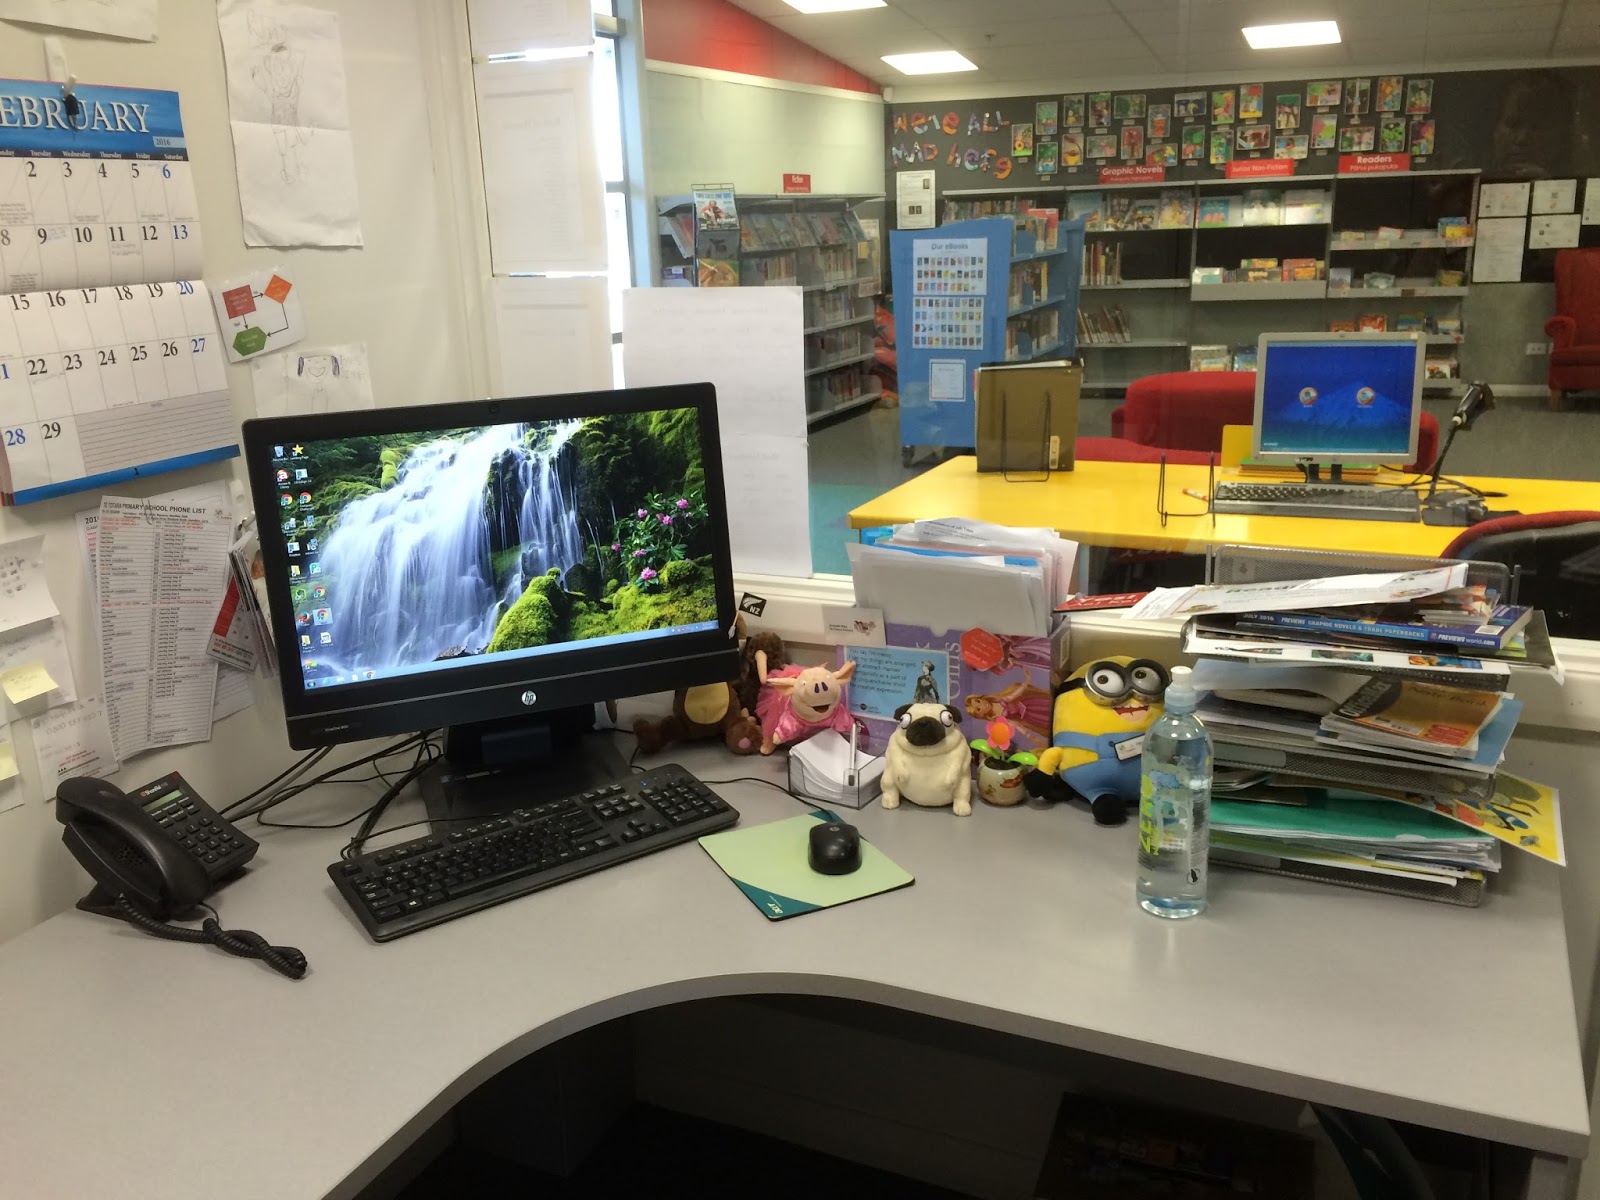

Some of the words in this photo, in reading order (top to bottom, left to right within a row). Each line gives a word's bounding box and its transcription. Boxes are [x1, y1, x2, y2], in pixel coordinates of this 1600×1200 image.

[155, 138, 171, 146] 2016
[30, 149, 51, 157] Tuesday
[62, 150, 91, 159] Wednesday
[99, 151, 122, 159] Thursday
[135, 152, 150, 161] Friday
[163, 153, 184, 161] Saturday
[1357, 155, 1392, 164] Readers
[27, 161, 37, 178] 2
[63, 161, 73, 178] 3
[98, 162, 108, 178] 4
[131, 162, 140, 179] 5
[162, 163, 171, 179] 6
[1102, 167, 1134, 176] Graphic
[1136, 165, 1163, 174] Novels
[1252, 164, 1289, 172] Non-Fiction
[0, 229, 11, 246] 8
[37, 228, 48, 245] 9
[75, 226, 93, 243] 10
[109, 226, 125, 242] 11
[142, 225, 158, 241] 12
[173, 224, 189, 240] 13
[114, 285, 134, 301] 18
[146, 282, 164, 298] 19
[176, 280, 194, 295] 20
[10, 294, 30, 311] 15
[46, 290, 66, 308] 16
[81, 288, 98, 304] 17
[161, 341, 178, 357] 26
[191, 337, 206, 353] 27
[98, 349, 117, 366] 24
[130, 345, 148, 362] 25
[26, 357, 48, 376] 22
[63, 353, 83, 371] 23
[5, 428, 26, 447] 28
[41, 421, 61, 440] 29
[122, 502, 144, 510] PRIMARY
[145, 503, 168, 512] SCHOOL
[169, 505, 191, 514] PHONE
[750, 605, 760, 615] NZ
[1281, 617, 1306, 625] PREVIEWS
[1308, 620, 1333, 628] GRAPHIC
[1384, 628, 1425, 638] PAPERBACKS
